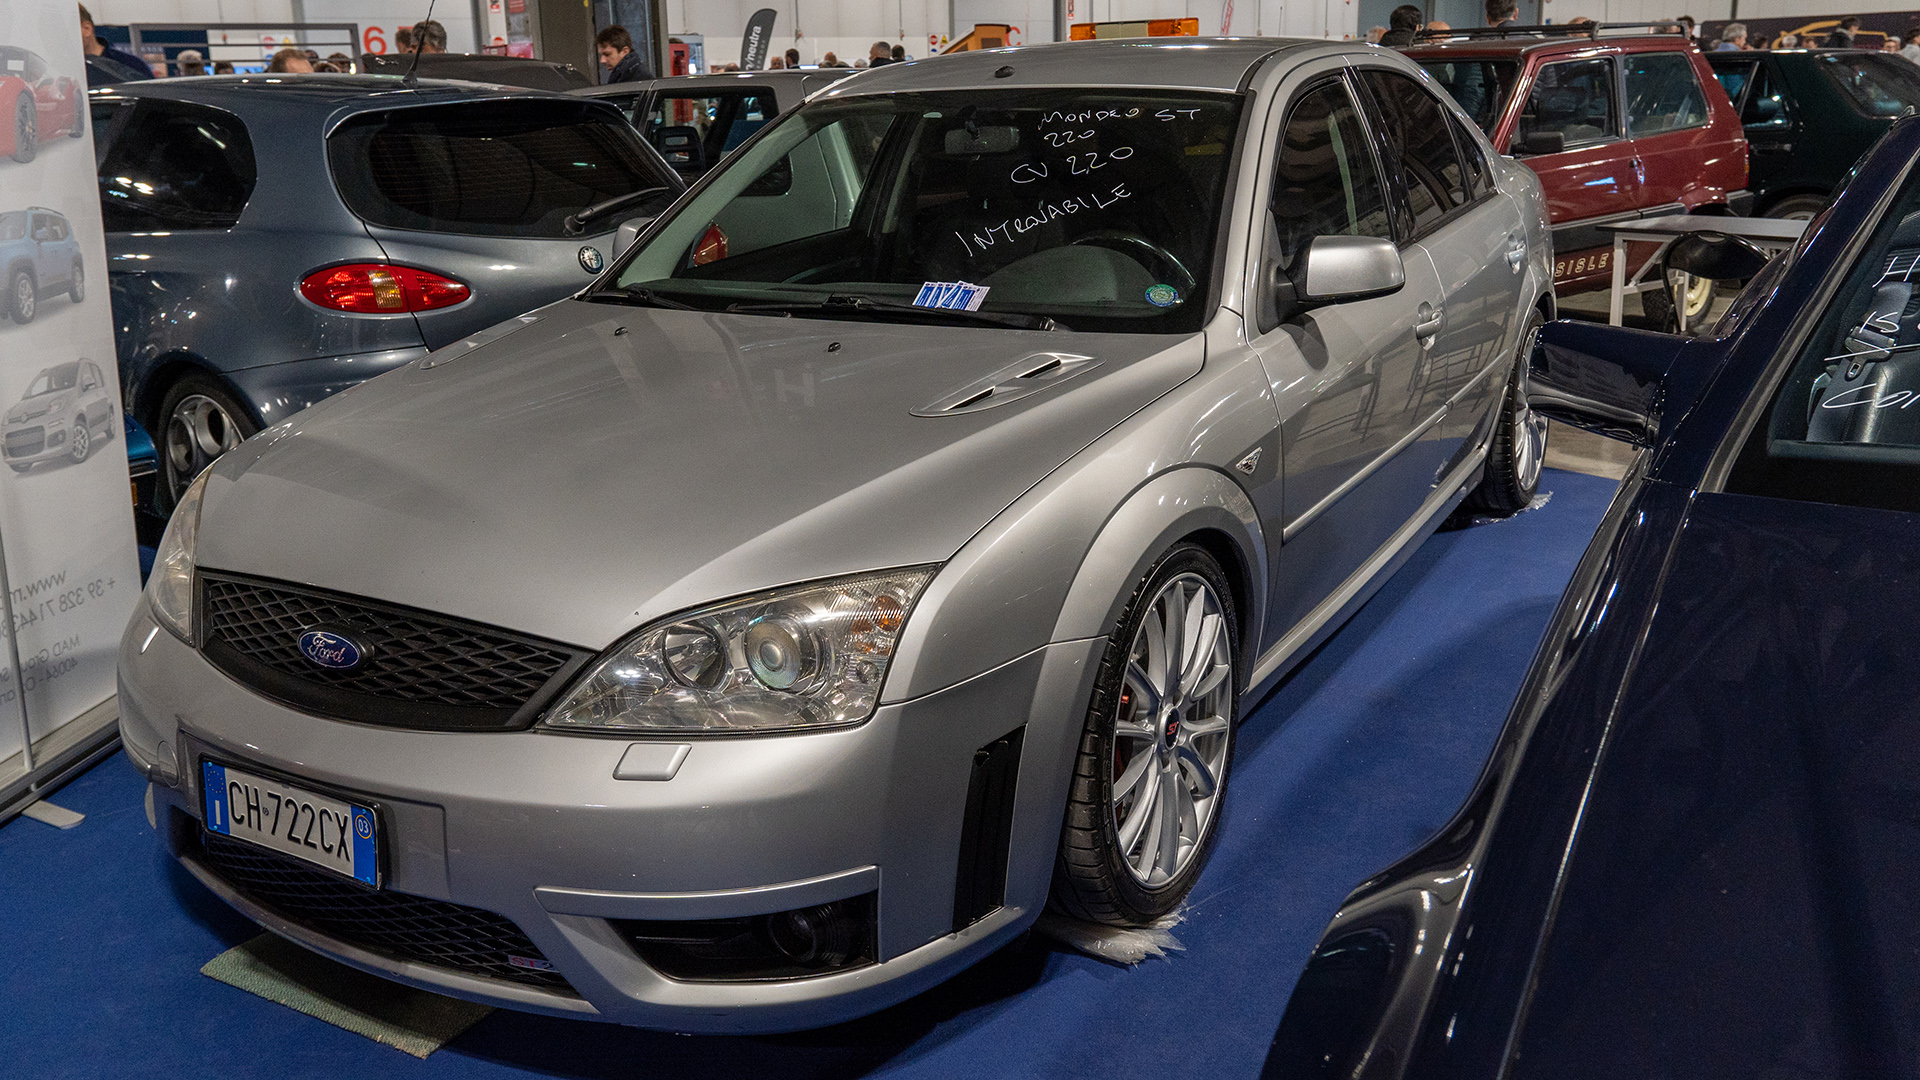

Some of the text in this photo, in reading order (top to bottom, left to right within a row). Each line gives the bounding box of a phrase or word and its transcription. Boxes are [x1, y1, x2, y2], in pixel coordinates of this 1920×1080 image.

[363, 26, 387, 55] 6
[1155, 108, 1201, 121] ST
[1044, 129, 1095, 147] 220
[1554, 253, 1615, 277] SISLE
[307, 634, 346, 663] Ford
[358, 822, 369, 834] 03
